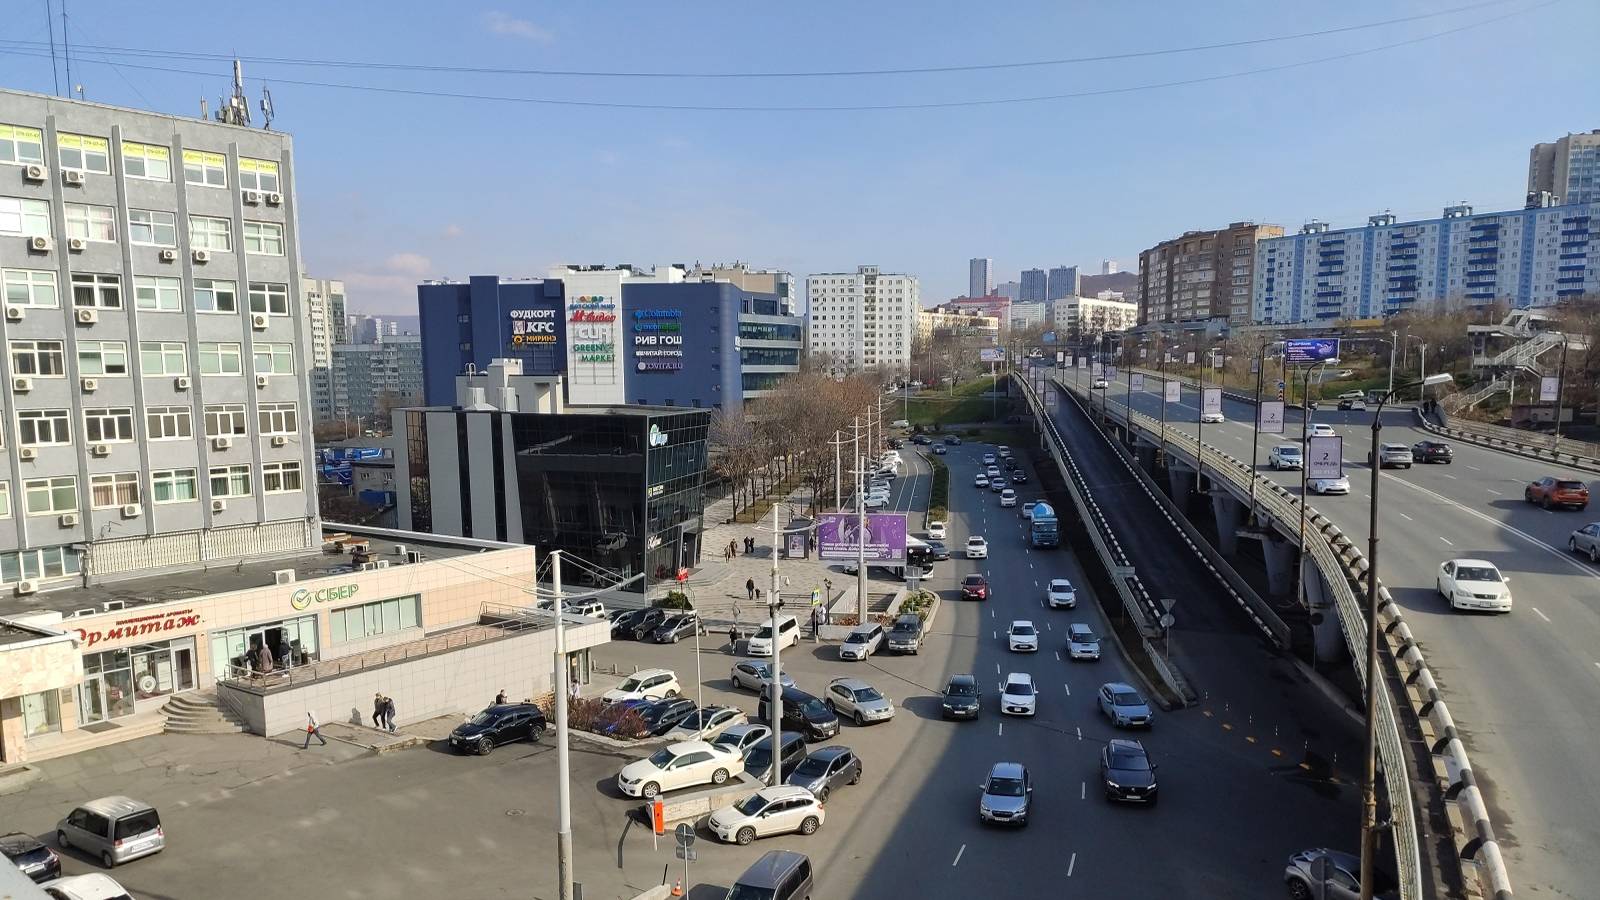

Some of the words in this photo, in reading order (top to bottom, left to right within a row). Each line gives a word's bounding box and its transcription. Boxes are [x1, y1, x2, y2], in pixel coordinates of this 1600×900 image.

[510, 309, 556, 319] ФУДКОРТ
[526, 321, 555, 333] KFC
[635, 335, 657, 345] РИВ
[659, 335, 682, 345] ГОШ
[1323, 452, 1329, 461] 2
[315, 584, 359, 603] СБЕР
